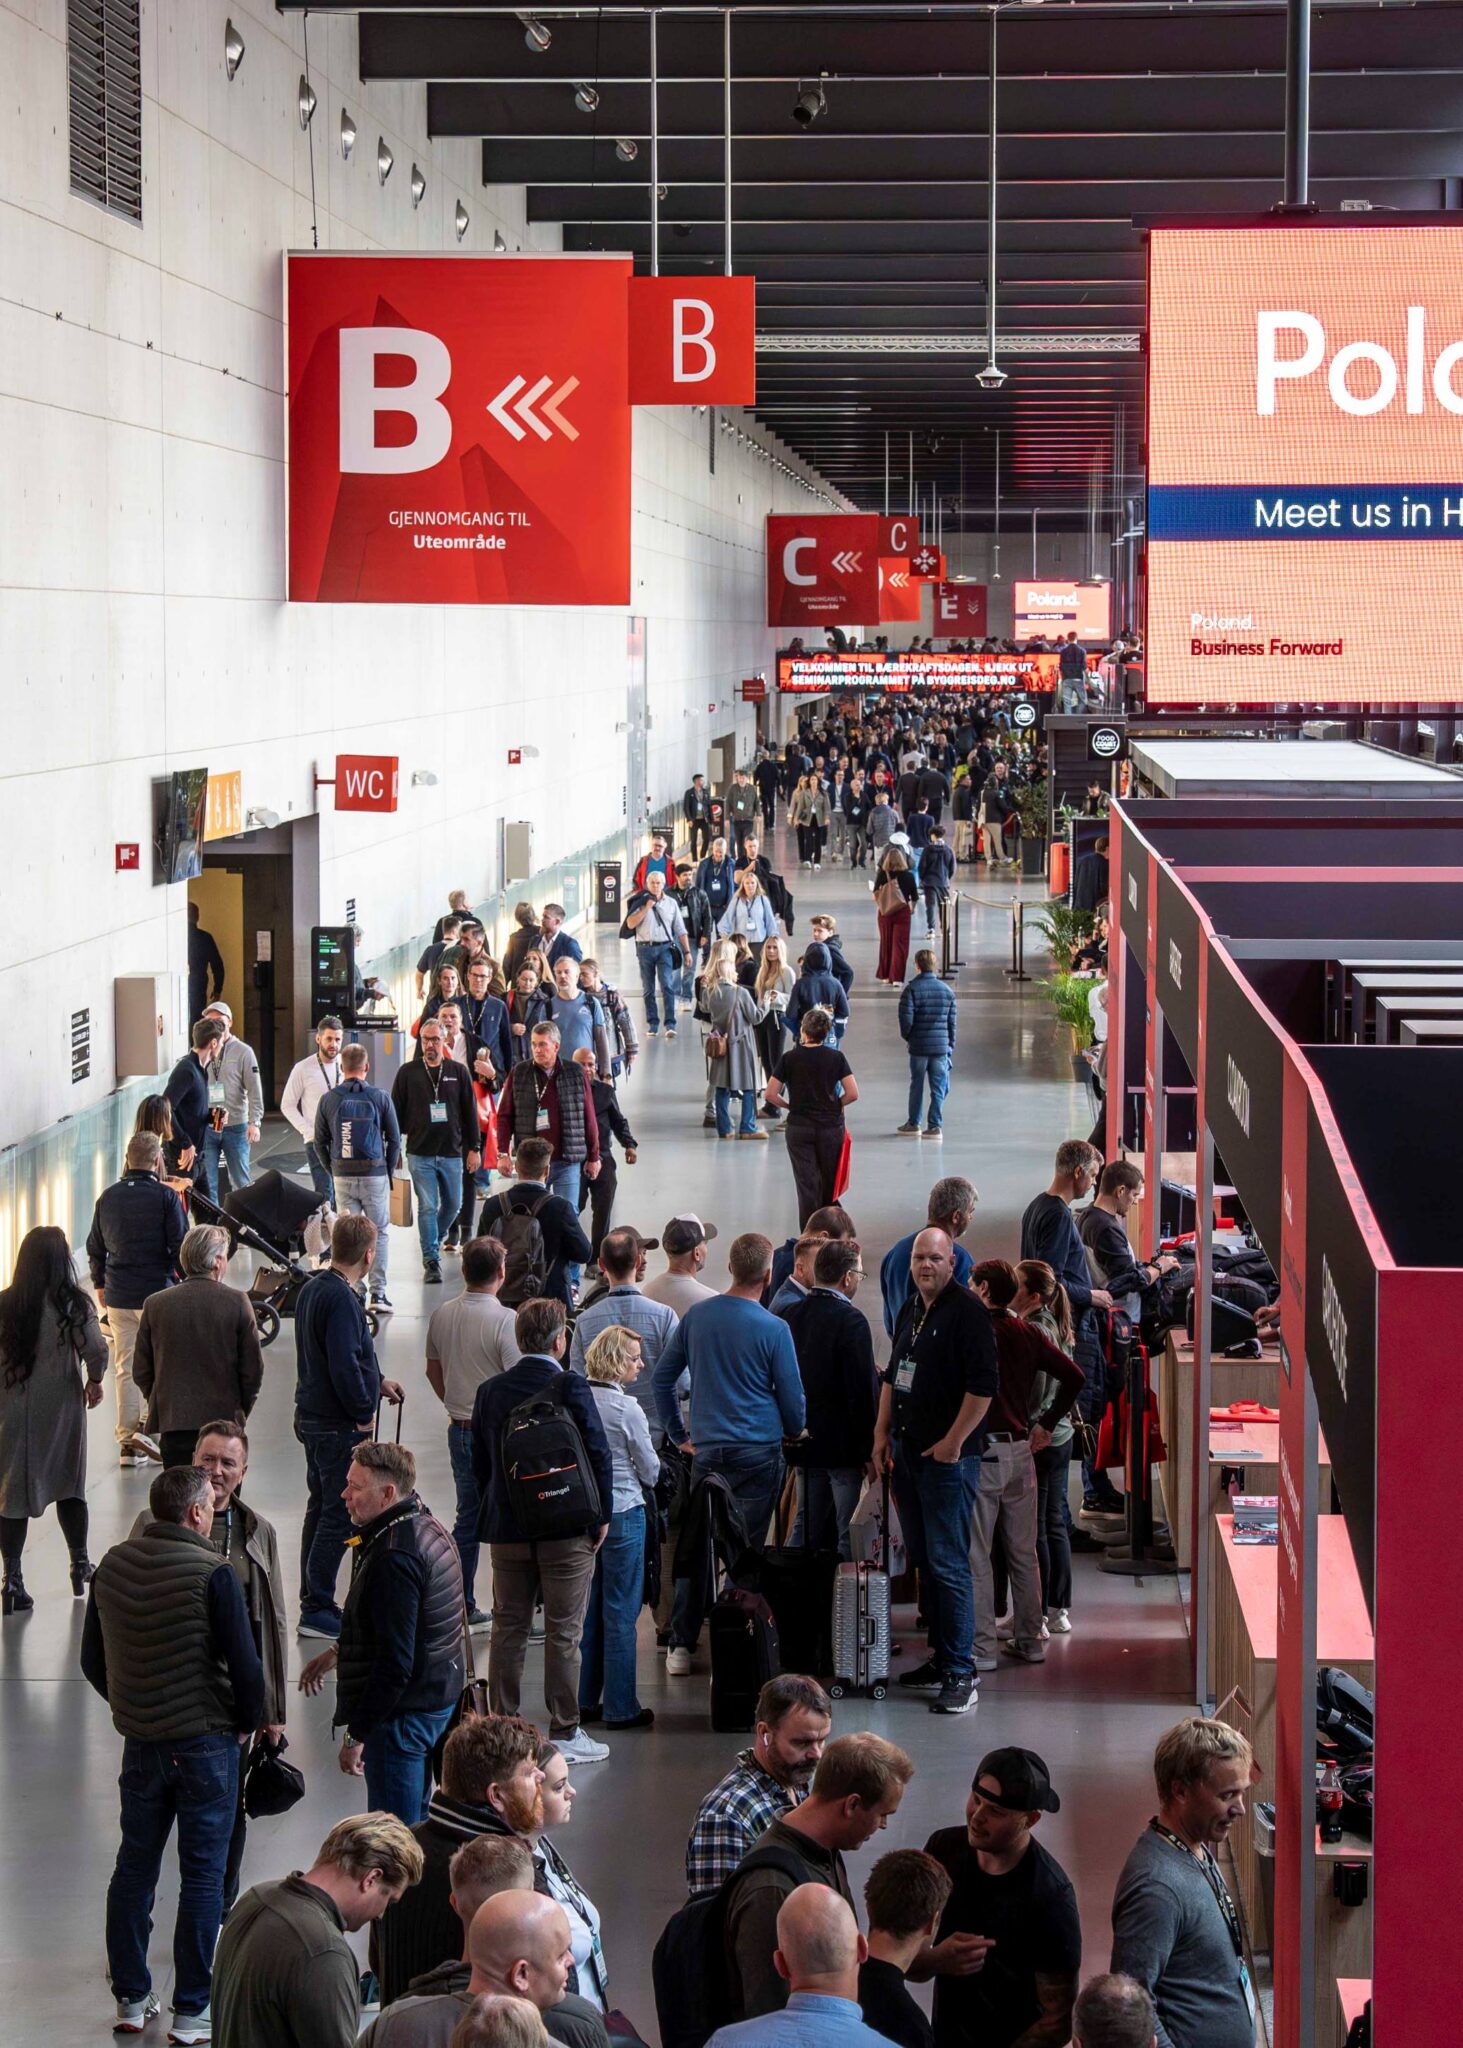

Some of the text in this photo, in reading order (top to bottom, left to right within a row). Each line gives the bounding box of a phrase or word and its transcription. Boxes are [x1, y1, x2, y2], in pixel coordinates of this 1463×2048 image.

[673, 299, 716, 383] B
[339, 327, 452, 474] B
[389, 511, 531, 528] GJENNOMGANG TIL
[1255, 499, 1341, 528] Meet
[1352, 504, 1391, 528] us
[1402, 496, 1431, 527] in
[413, 534, 506, 549] Uteområde
[890, 523, 907, 551] C
[783, 537, 817, 586] C
[941, 595, 958, 619] E
[1191, 639, 1343, 656] Business Forward
[791, 662, 857, 673] VELKOMMEN
[858, 662, 875, 673] TIL
[984, 662, 1017, 673] SJEKK
[1019, 662, 1033, 673] UT
[791, 675, 910, 685] SEMINARPROGRAMMET
[911, 673, 926, 685] PÅ
[345, 769, 384, 799] WC
[341, 1121, 352, 1146] PUMA
[545, 1485, 570, 1498] Triangel
